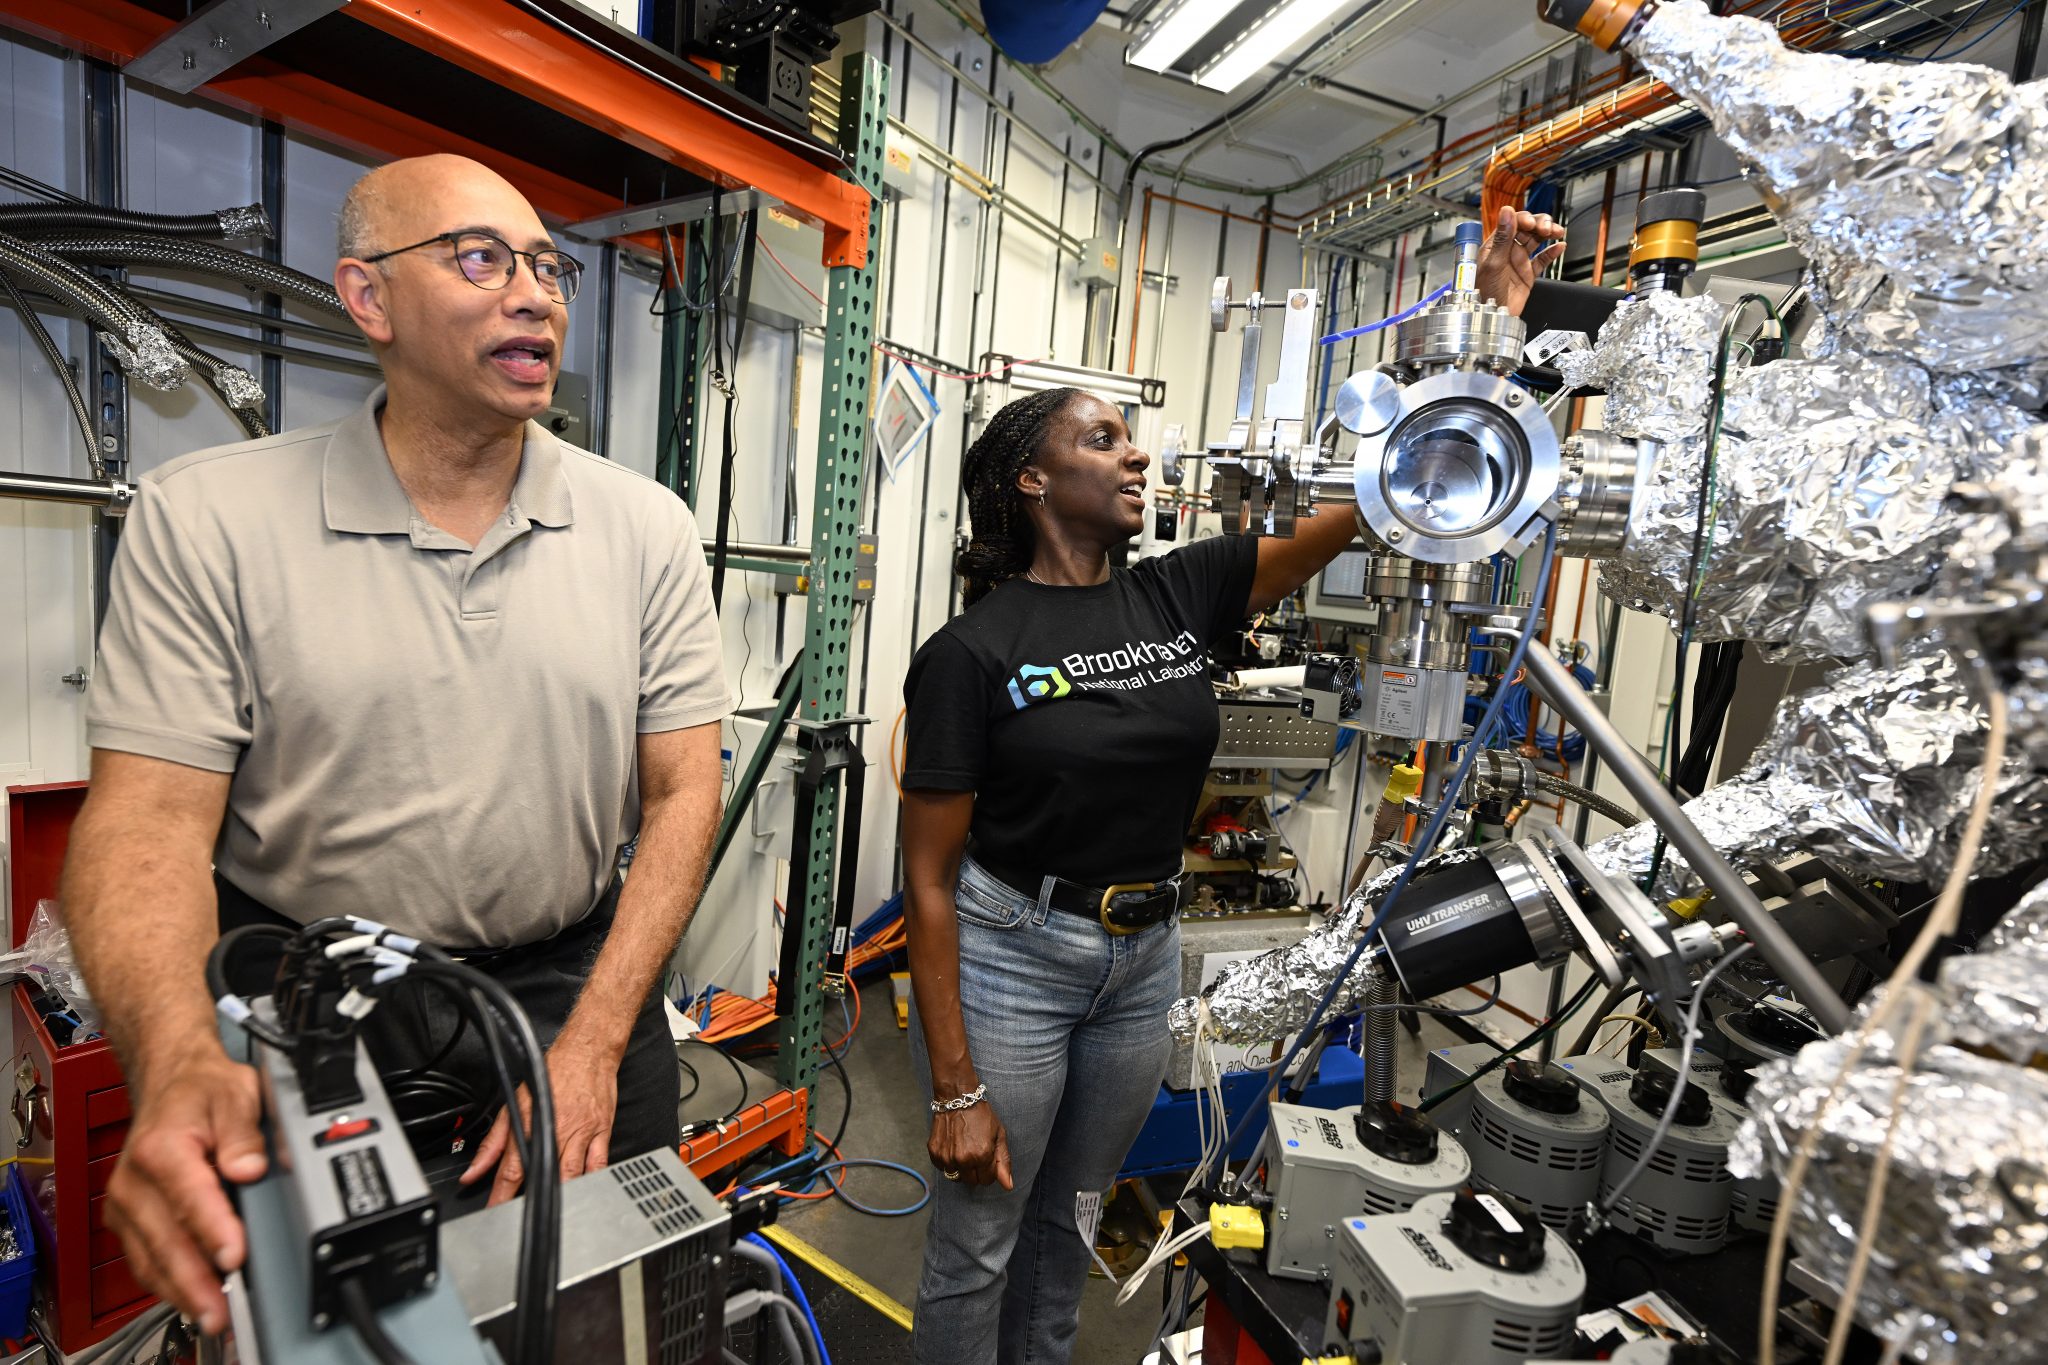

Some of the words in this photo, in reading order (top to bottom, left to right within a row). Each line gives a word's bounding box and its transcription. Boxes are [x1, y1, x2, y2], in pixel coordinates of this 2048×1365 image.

[1077, 672, 1147, 691] National
[1406, 914, 1432, 932] UHV
[1432, 893, 1491, 922] TRANSFER
[1329, 1123, 1344, 1149] STACO
